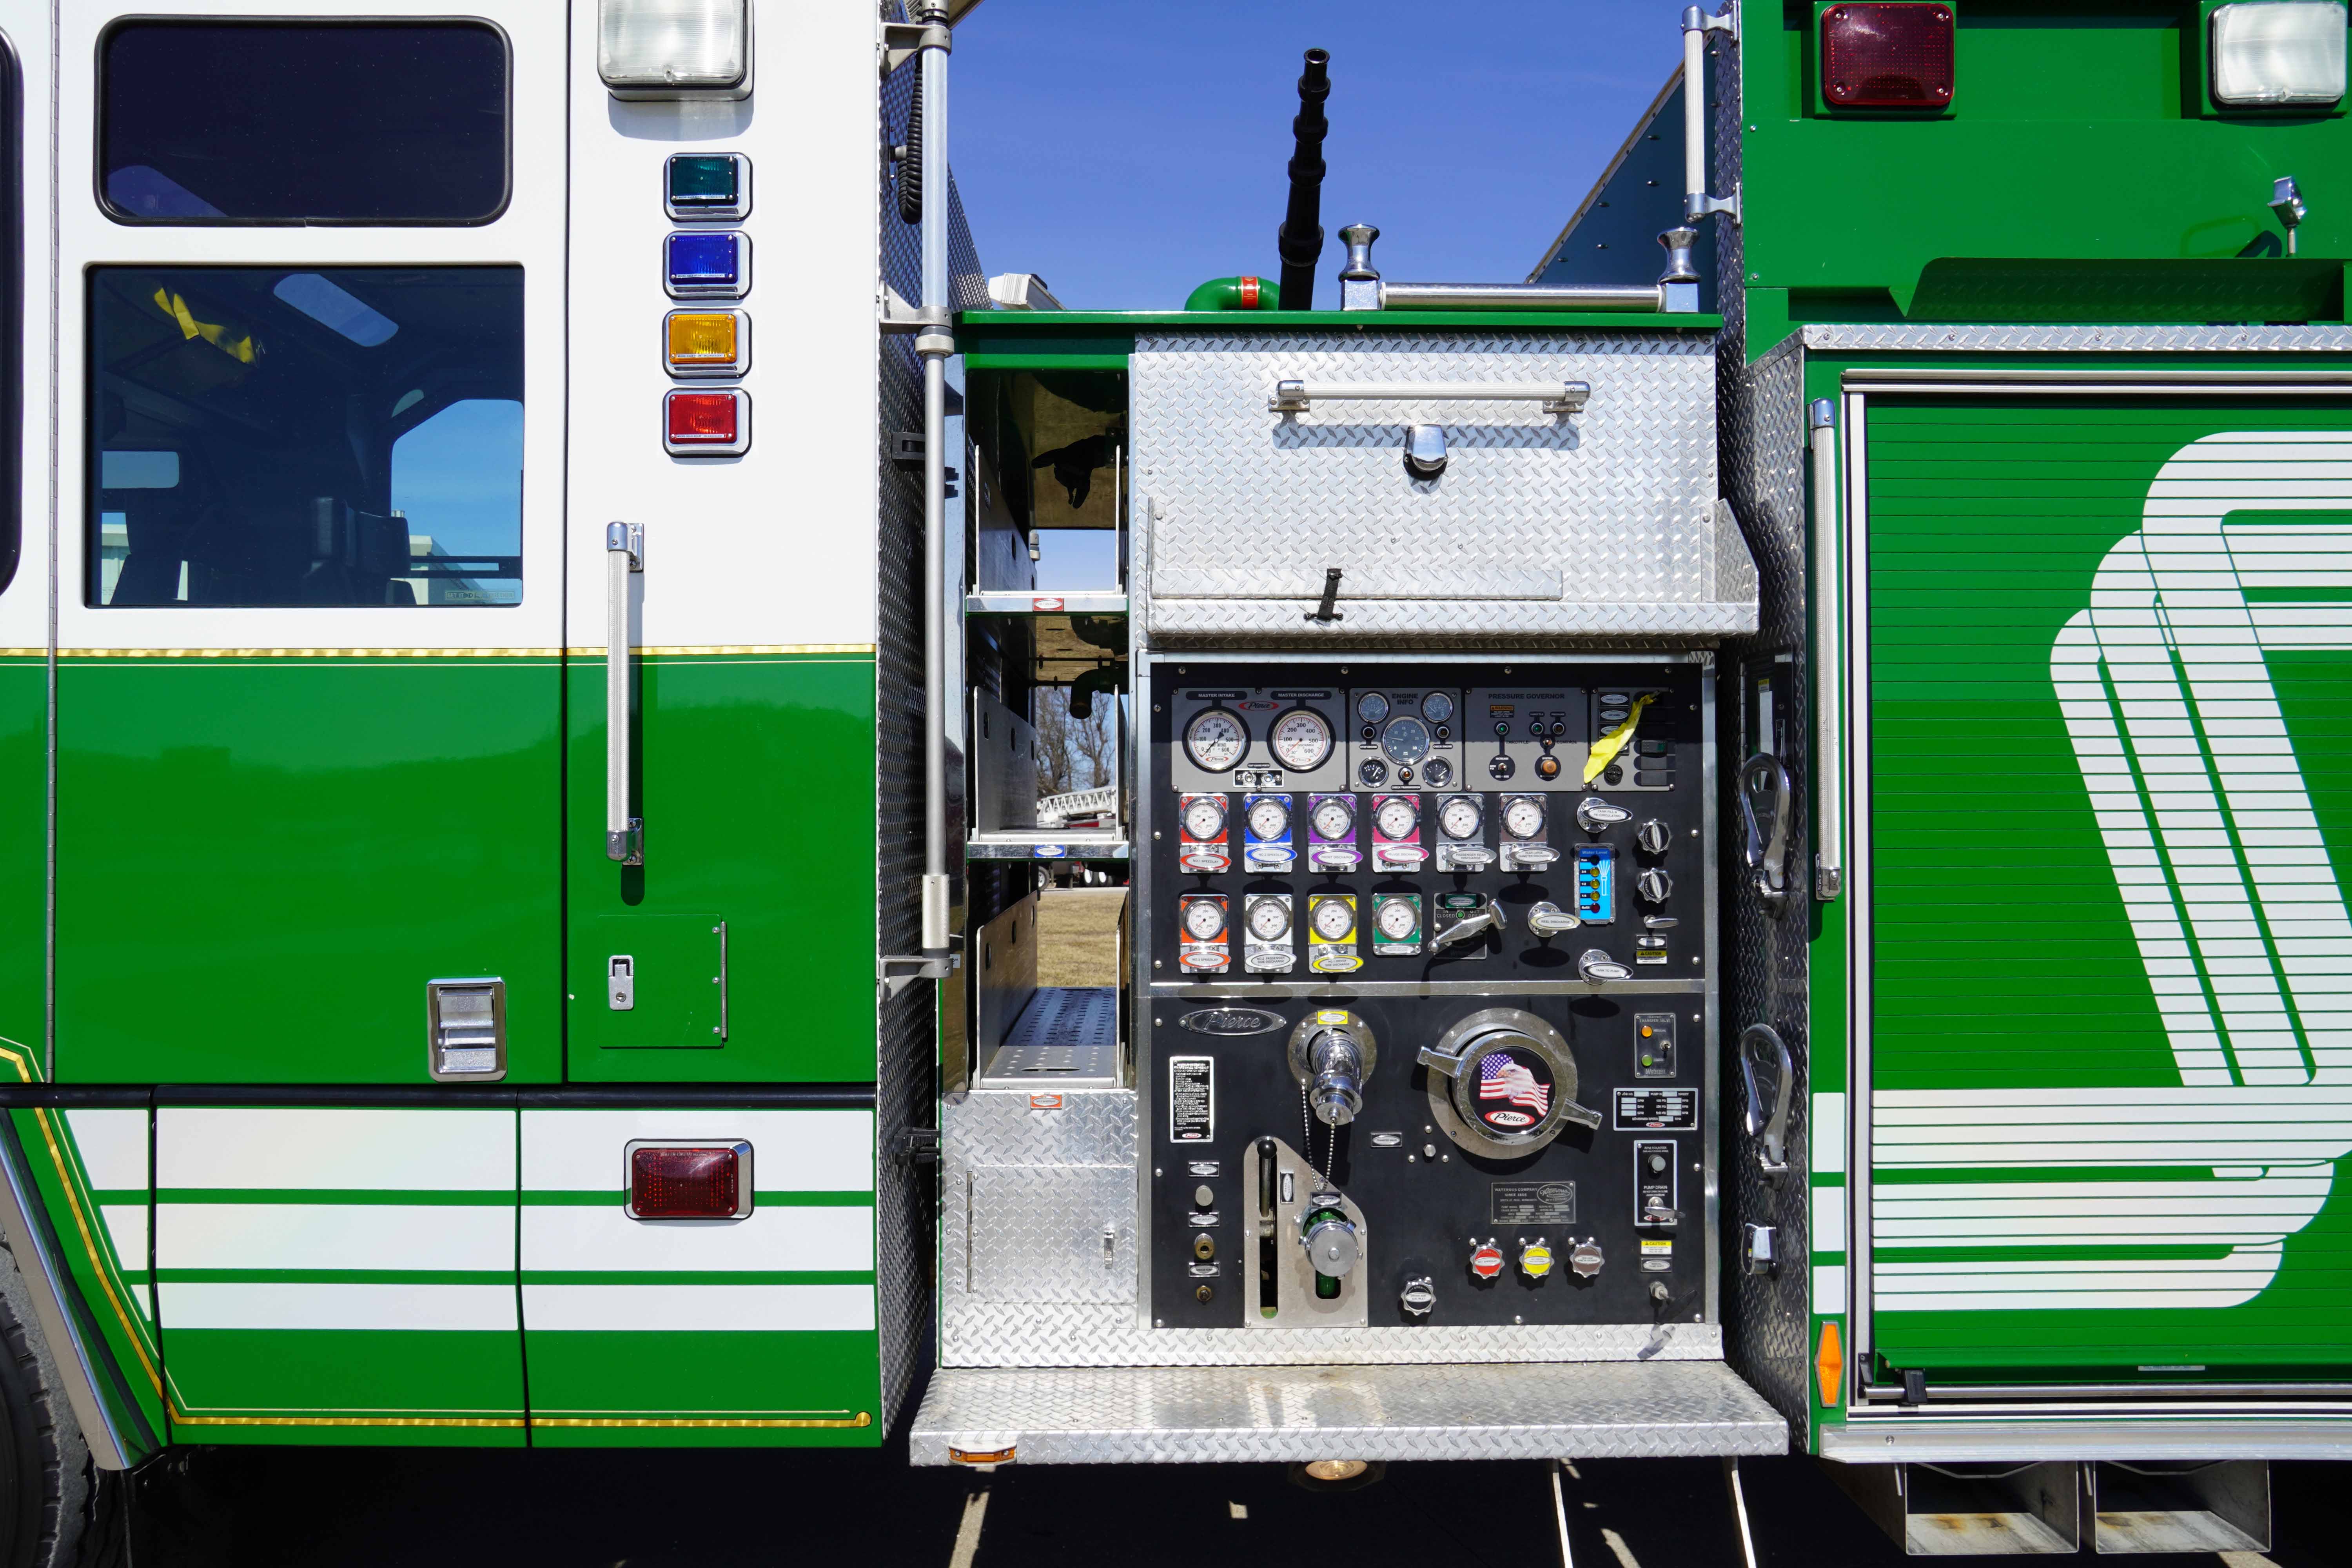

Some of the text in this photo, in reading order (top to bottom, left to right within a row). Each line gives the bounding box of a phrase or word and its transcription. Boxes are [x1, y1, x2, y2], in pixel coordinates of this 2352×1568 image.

[1203, 1013, 1261, 1031] Pierce
[1494, 1112, 1526, 1123] Pierce
[1540, 1187, 1568, 1196] Waterous
